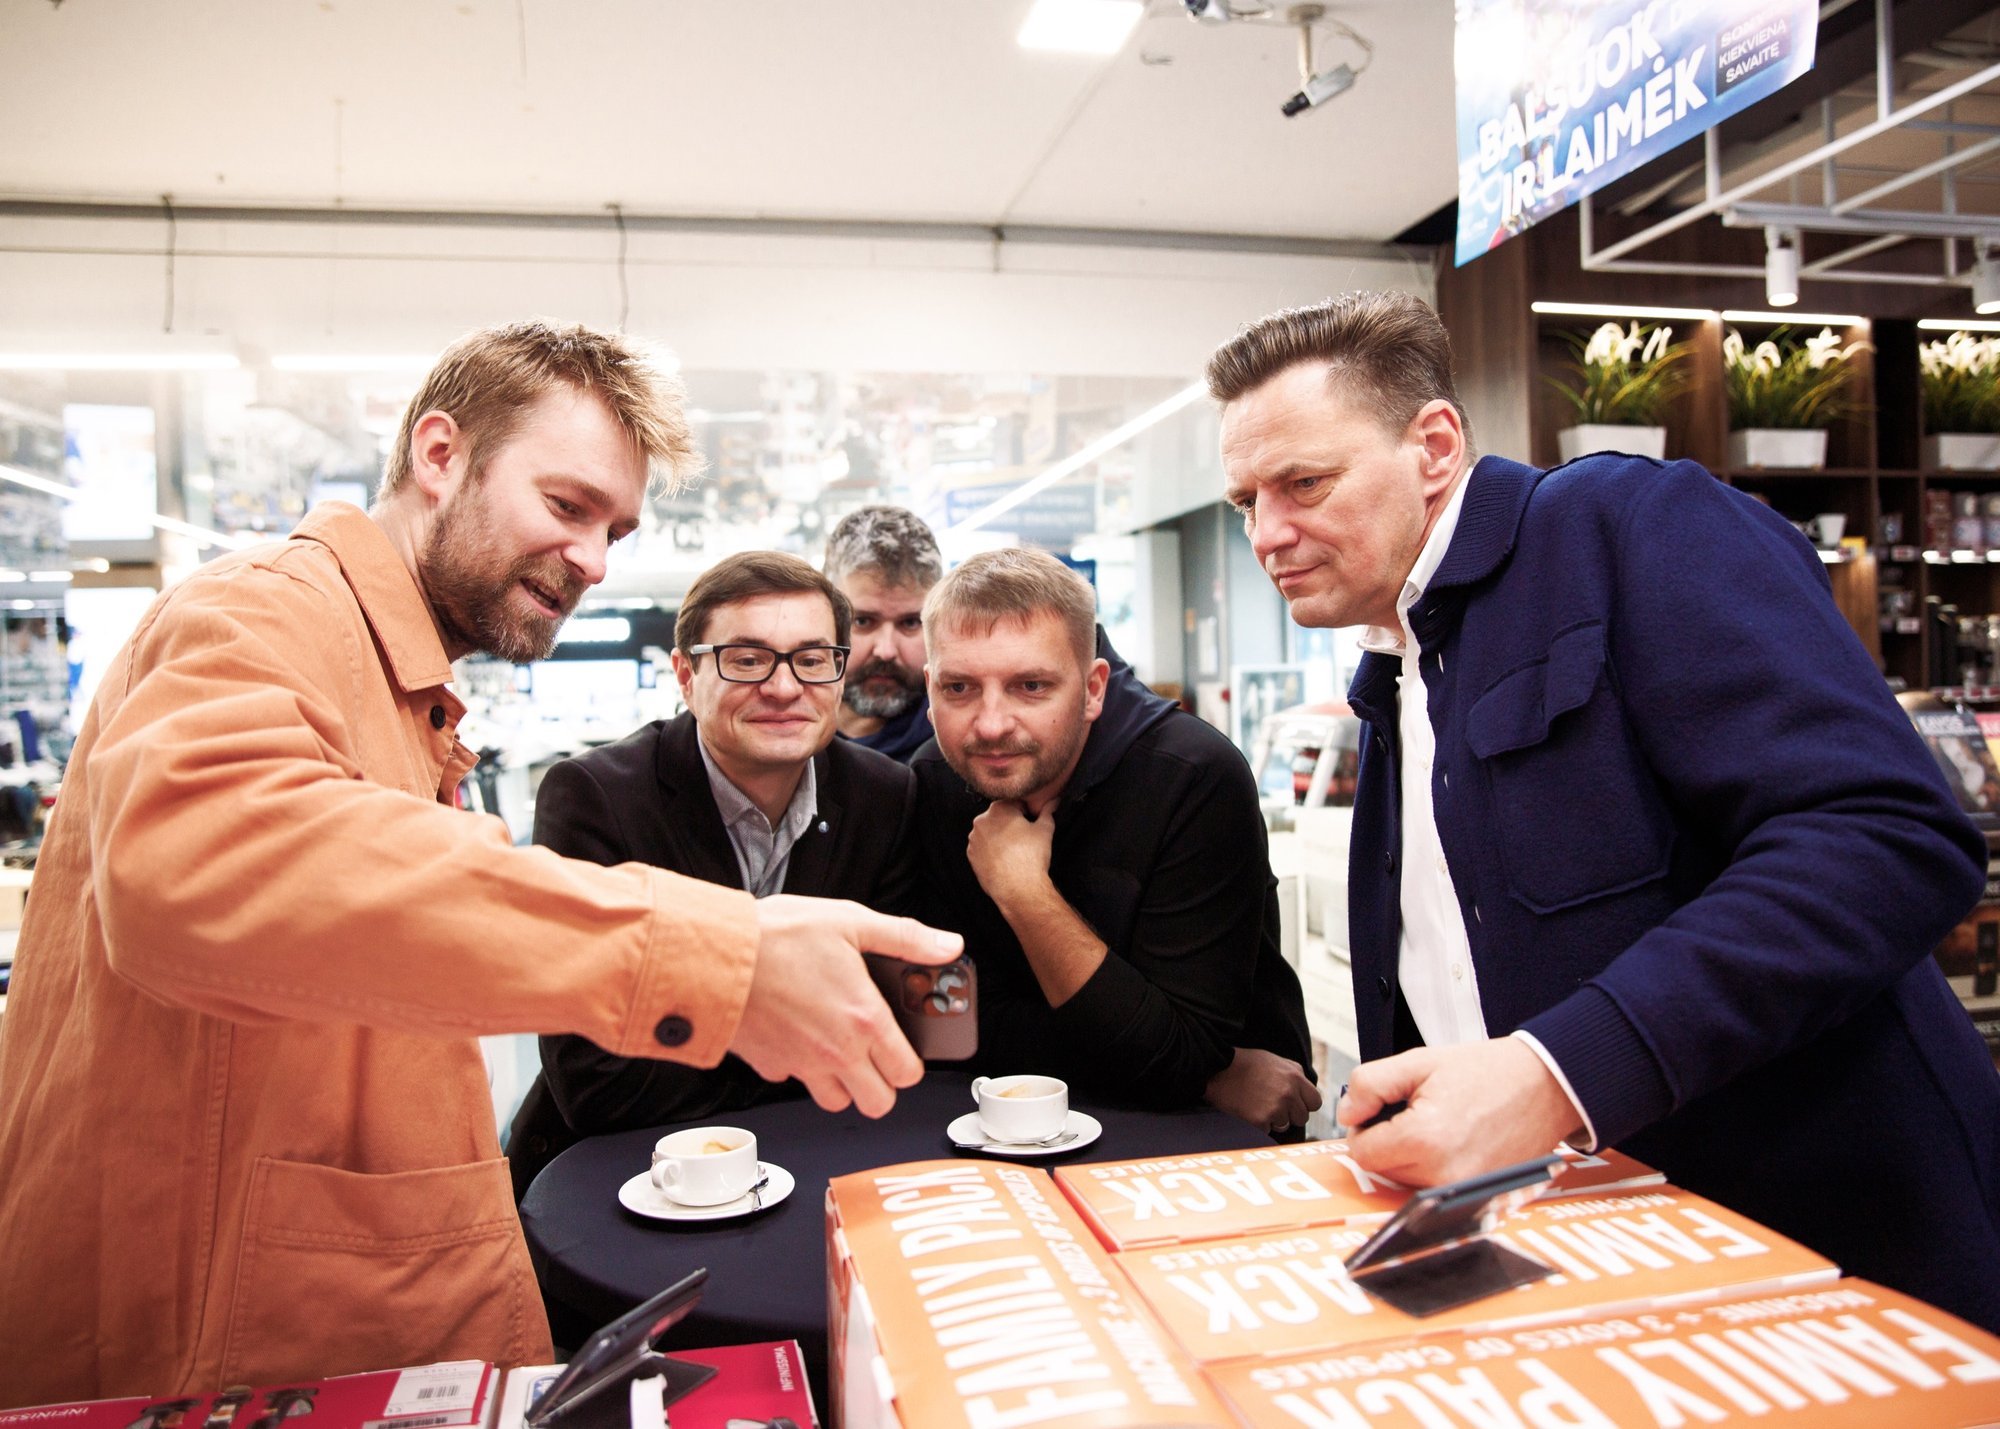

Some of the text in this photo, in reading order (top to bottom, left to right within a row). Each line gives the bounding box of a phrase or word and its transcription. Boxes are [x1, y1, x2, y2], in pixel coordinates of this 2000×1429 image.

[1725, 41, 1781, 84] SAVAITĘ
[1479, 2, 1662, 174] BALSUOK
[1501, 159, 1537, 221] IR
[1541, 44, 1709, 197] LAIMĖK
[1089, 1142, 1350, 1180] OXES OF CAPSULES
[994, 1168, 1061, 1224] CAPSULES
[1100, 1160, 1333, 1222] PACK
[1536, 1192, 1678, 1221] MACHINE
[1150, 1230, 1369, 1272] OF CAPSULES
[1500, 1207, 1771, 1286] FAMI
[873, 1166, 1130, 1429] FAMILY PACK
[1165, 1255, 1375, 1334] ACK
[1703, 1288, 1876, 1324] MACHINE
[1513, 1318, 1643, 1352] BOXES
[1637, 1315, 1676, 1334] 3
[773, 1345, 795, 1392] INFINISSIMA
[1249, 1345, 1456, 1391] CAPSULES
[1463, 1336, 1516, 1361] OF
[1594, 1308, 2000, 1429] FAMILY
[0, 1407, 89, 1424] INFINISSI
